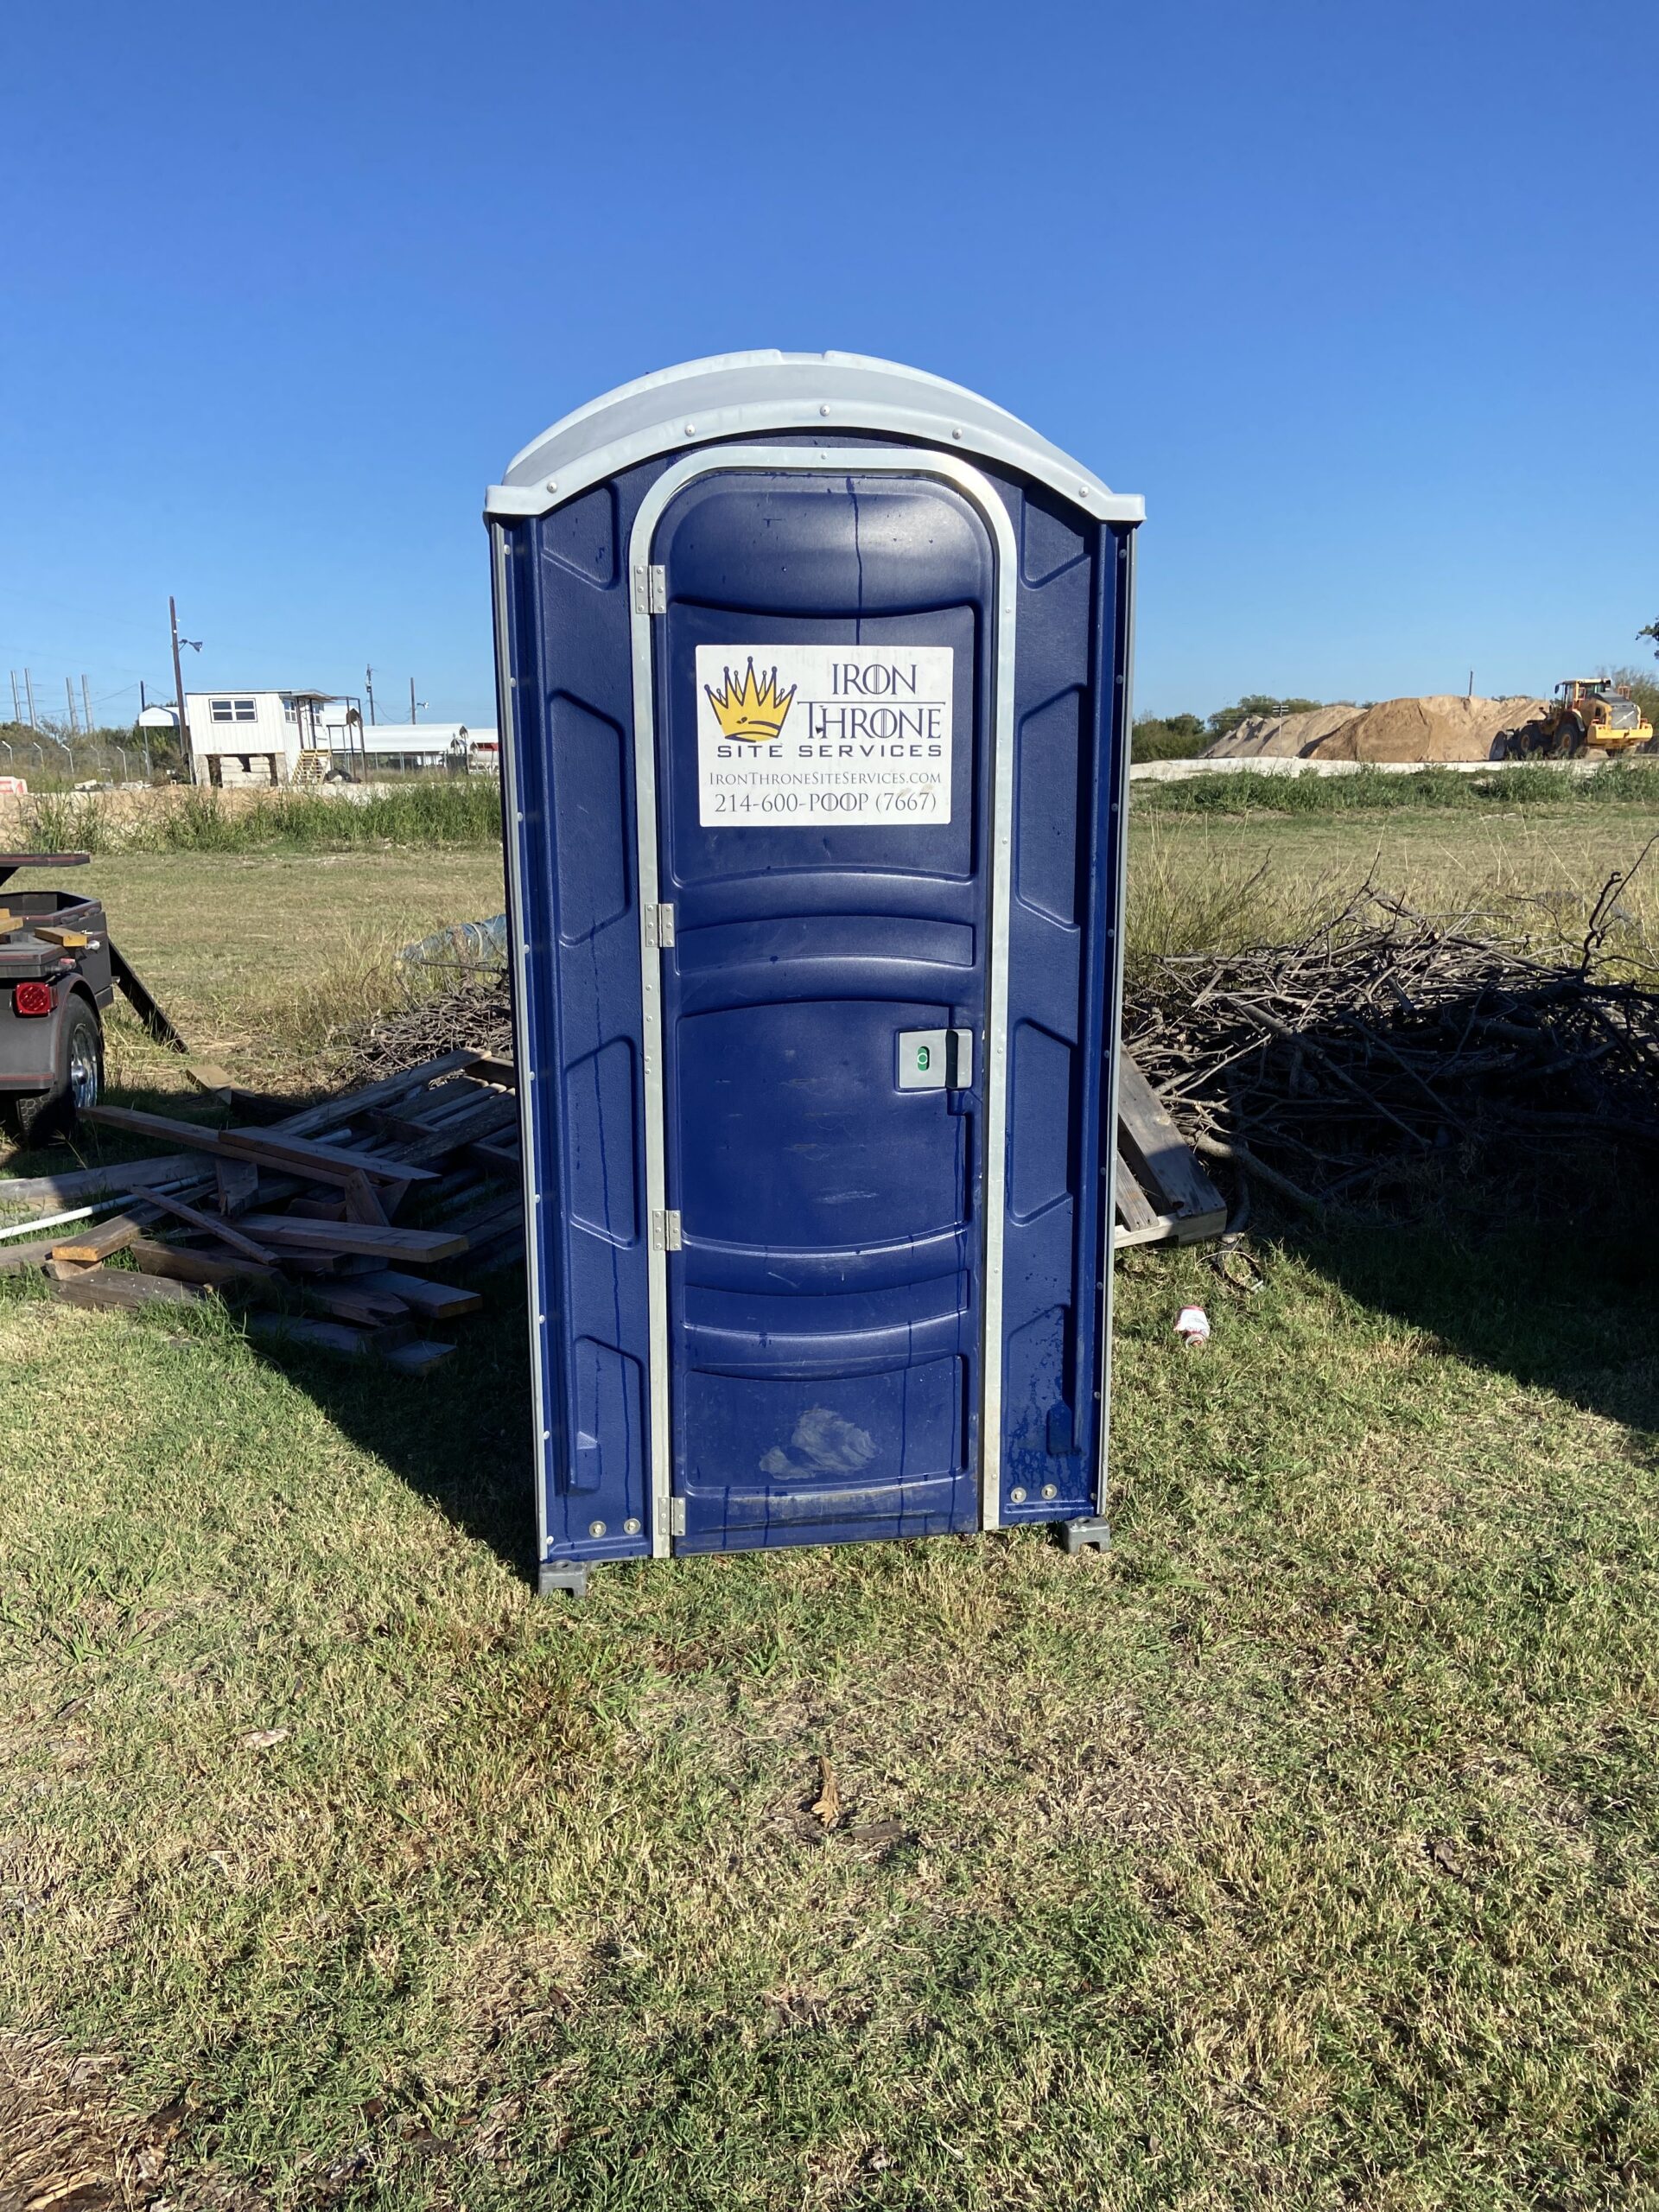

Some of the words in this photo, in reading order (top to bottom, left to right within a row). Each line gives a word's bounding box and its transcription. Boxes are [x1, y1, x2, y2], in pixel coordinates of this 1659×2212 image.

[832, 663, 918, 696] IRON
[797, 701, 946, 740] THRONE
[717, 745, 783, 759] SITE
[798, 745, 943, 759] SERVICES
[715, 792, 869, 813] 214-600-POOP
[875, 792, 938, 813] (7667)
